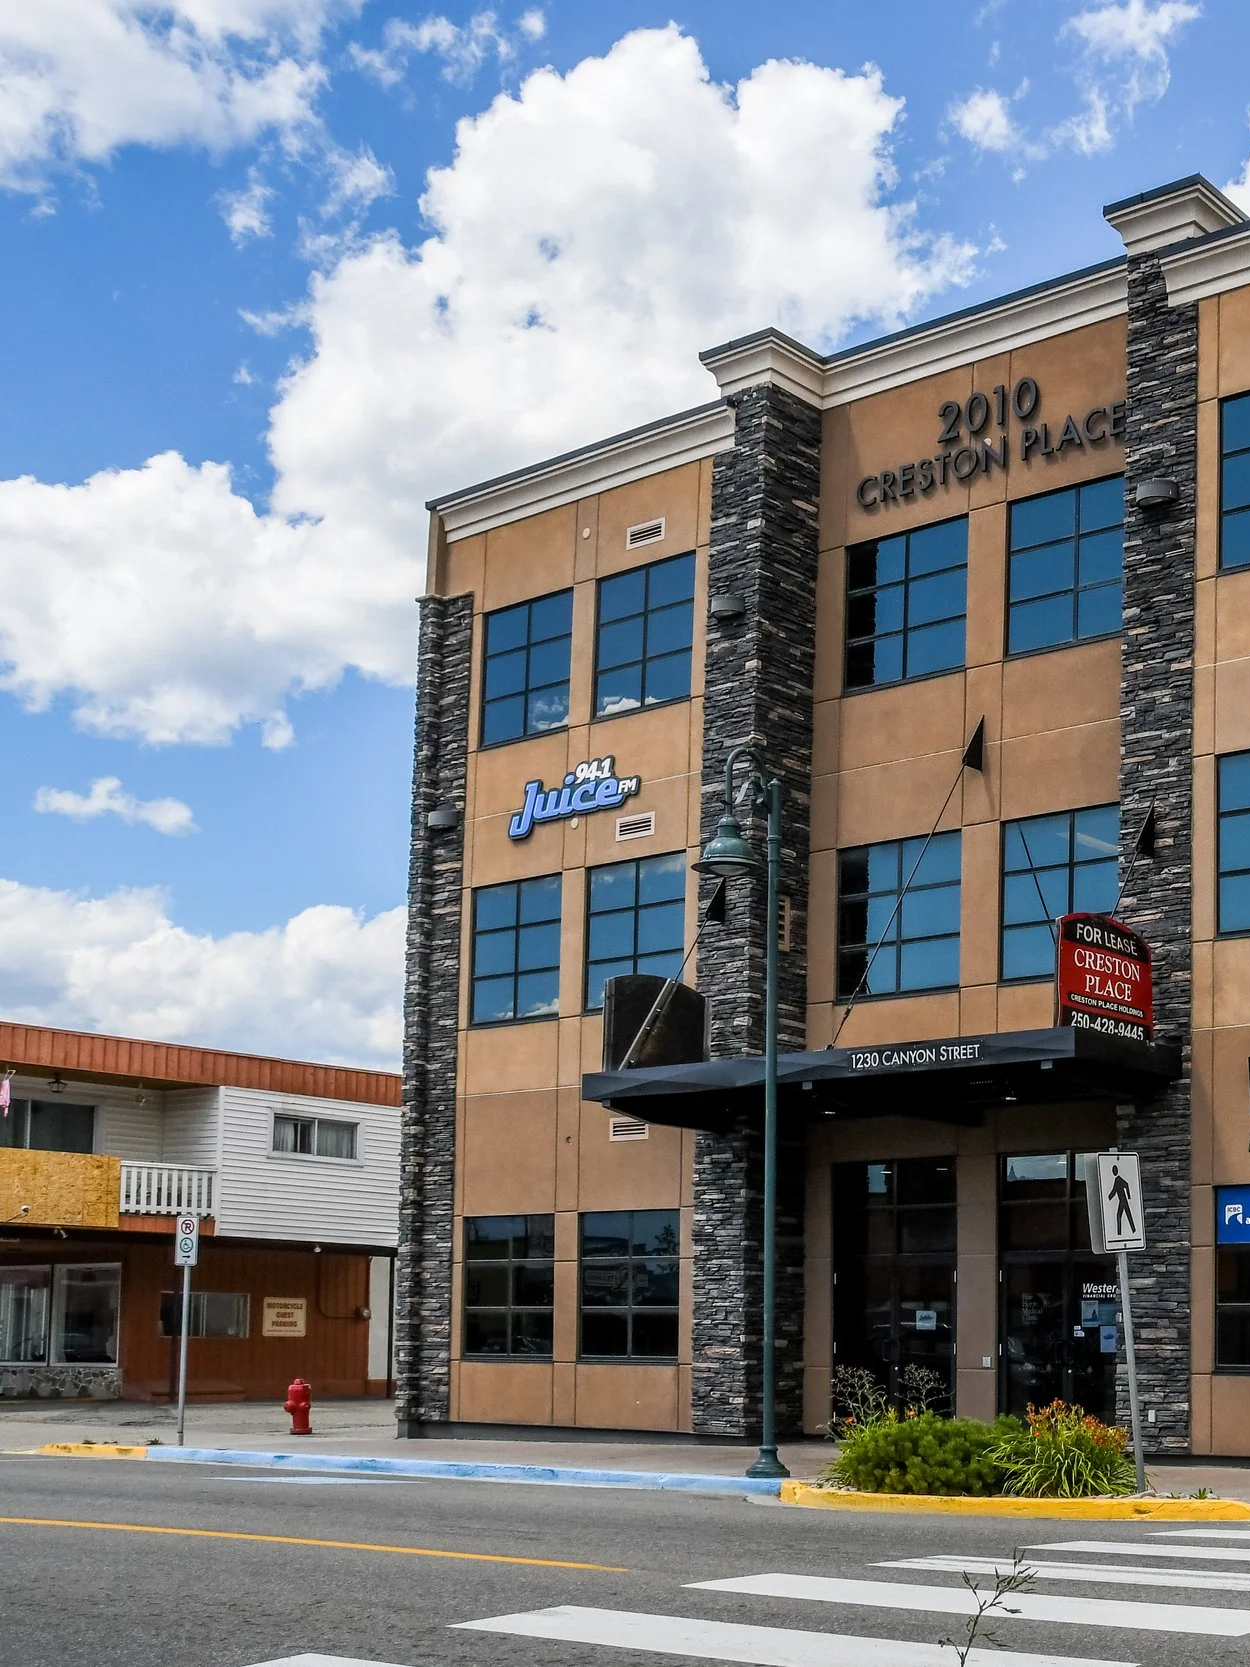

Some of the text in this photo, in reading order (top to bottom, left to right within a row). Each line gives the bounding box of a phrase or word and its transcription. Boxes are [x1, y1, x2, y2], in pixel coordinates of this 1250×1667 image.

[937, 376, 1039, 444] 2010
[856, 399, 1126, 508] CRESTON PLACE
[574, 757, 612, 784] 94.1
[509, 774, 638, 837] Juice FM
[1076, 923, 1138, 956] FOR LEASE
[1074, 948, 1141, 982] CRESTON
[1085, 974, 1132, 1002] PLACE
[1070, 993, 1144, 1018] CRESTON PLACE HOLDINGS
[1071, 1011, 1144, 1041] 250-428-9445
[851, 1044, 981, 1069] 1230 CANYON STREET
[1082, 1283, 1118, 1294] Wester
